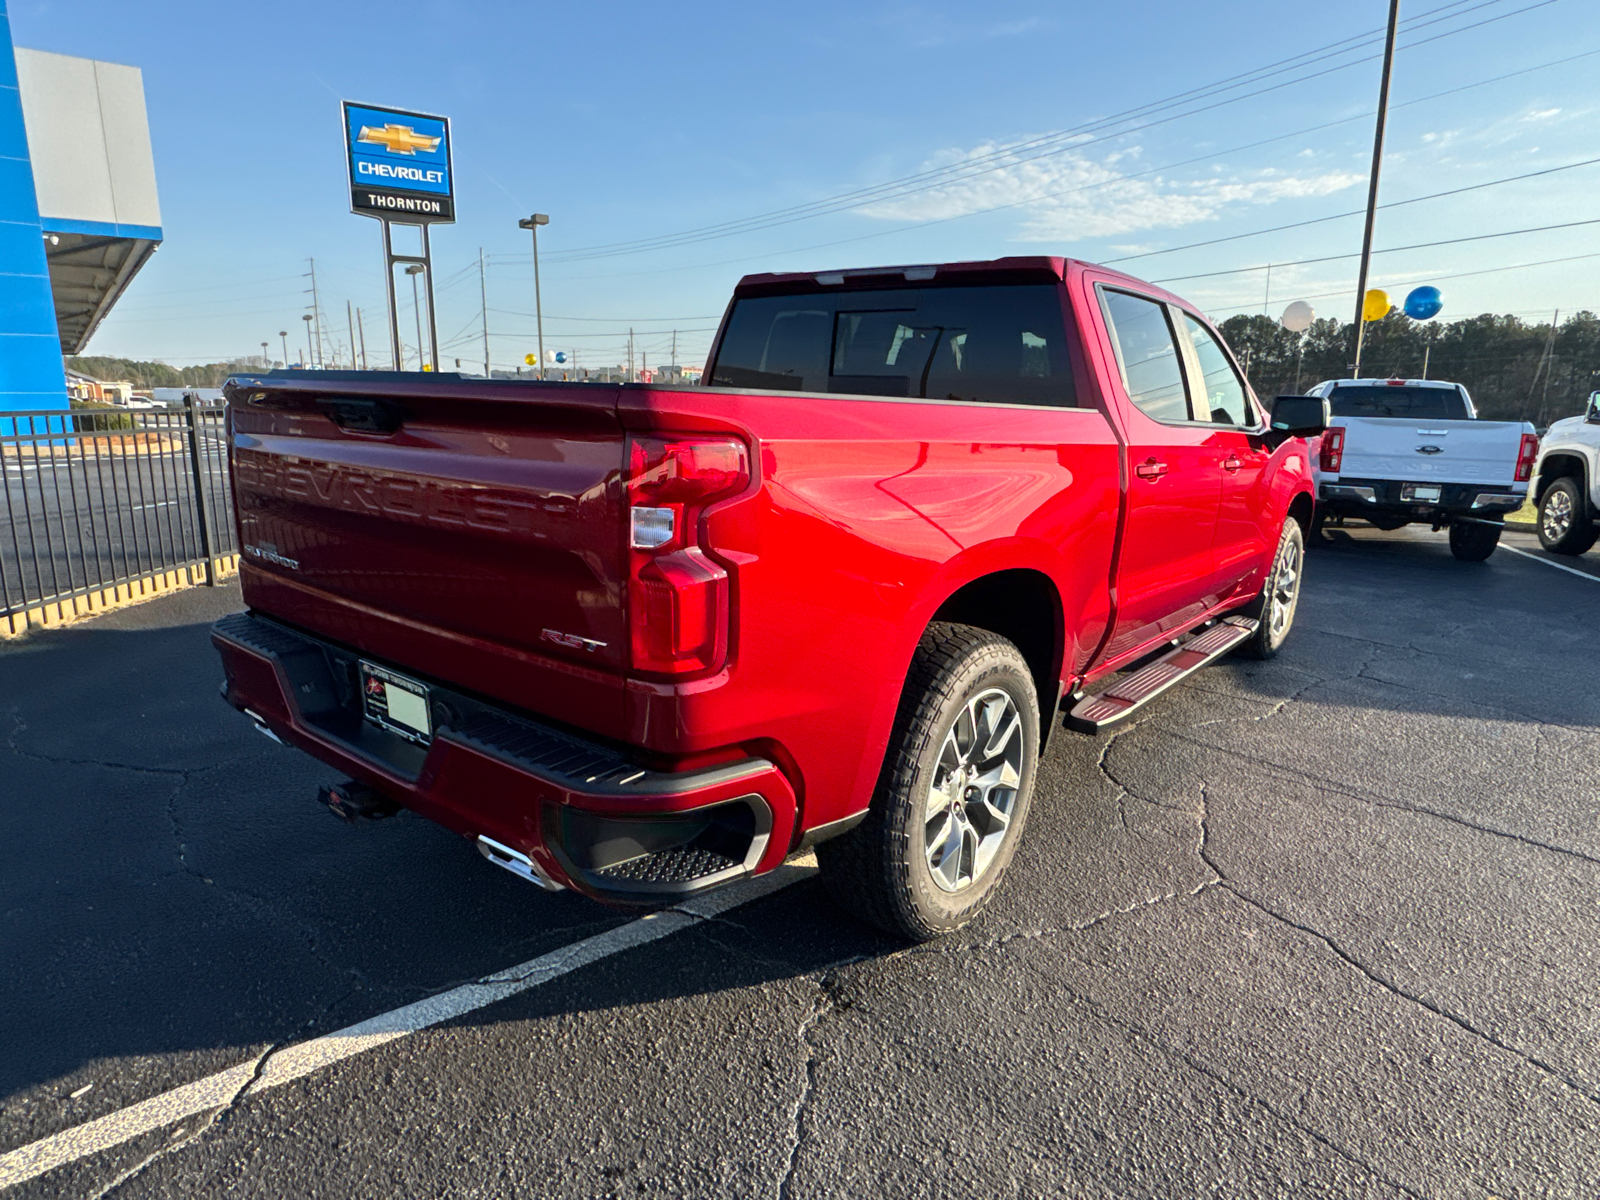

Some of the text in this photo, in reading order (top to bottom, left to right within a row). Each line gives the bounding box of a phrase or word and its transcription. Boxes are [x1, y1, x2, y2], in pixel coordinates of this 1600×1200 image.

[358, 161, 444, 183] CHEVROLET
[368, 194, 440, 213] THORNTON
[538, 628, 609, 653] RST
